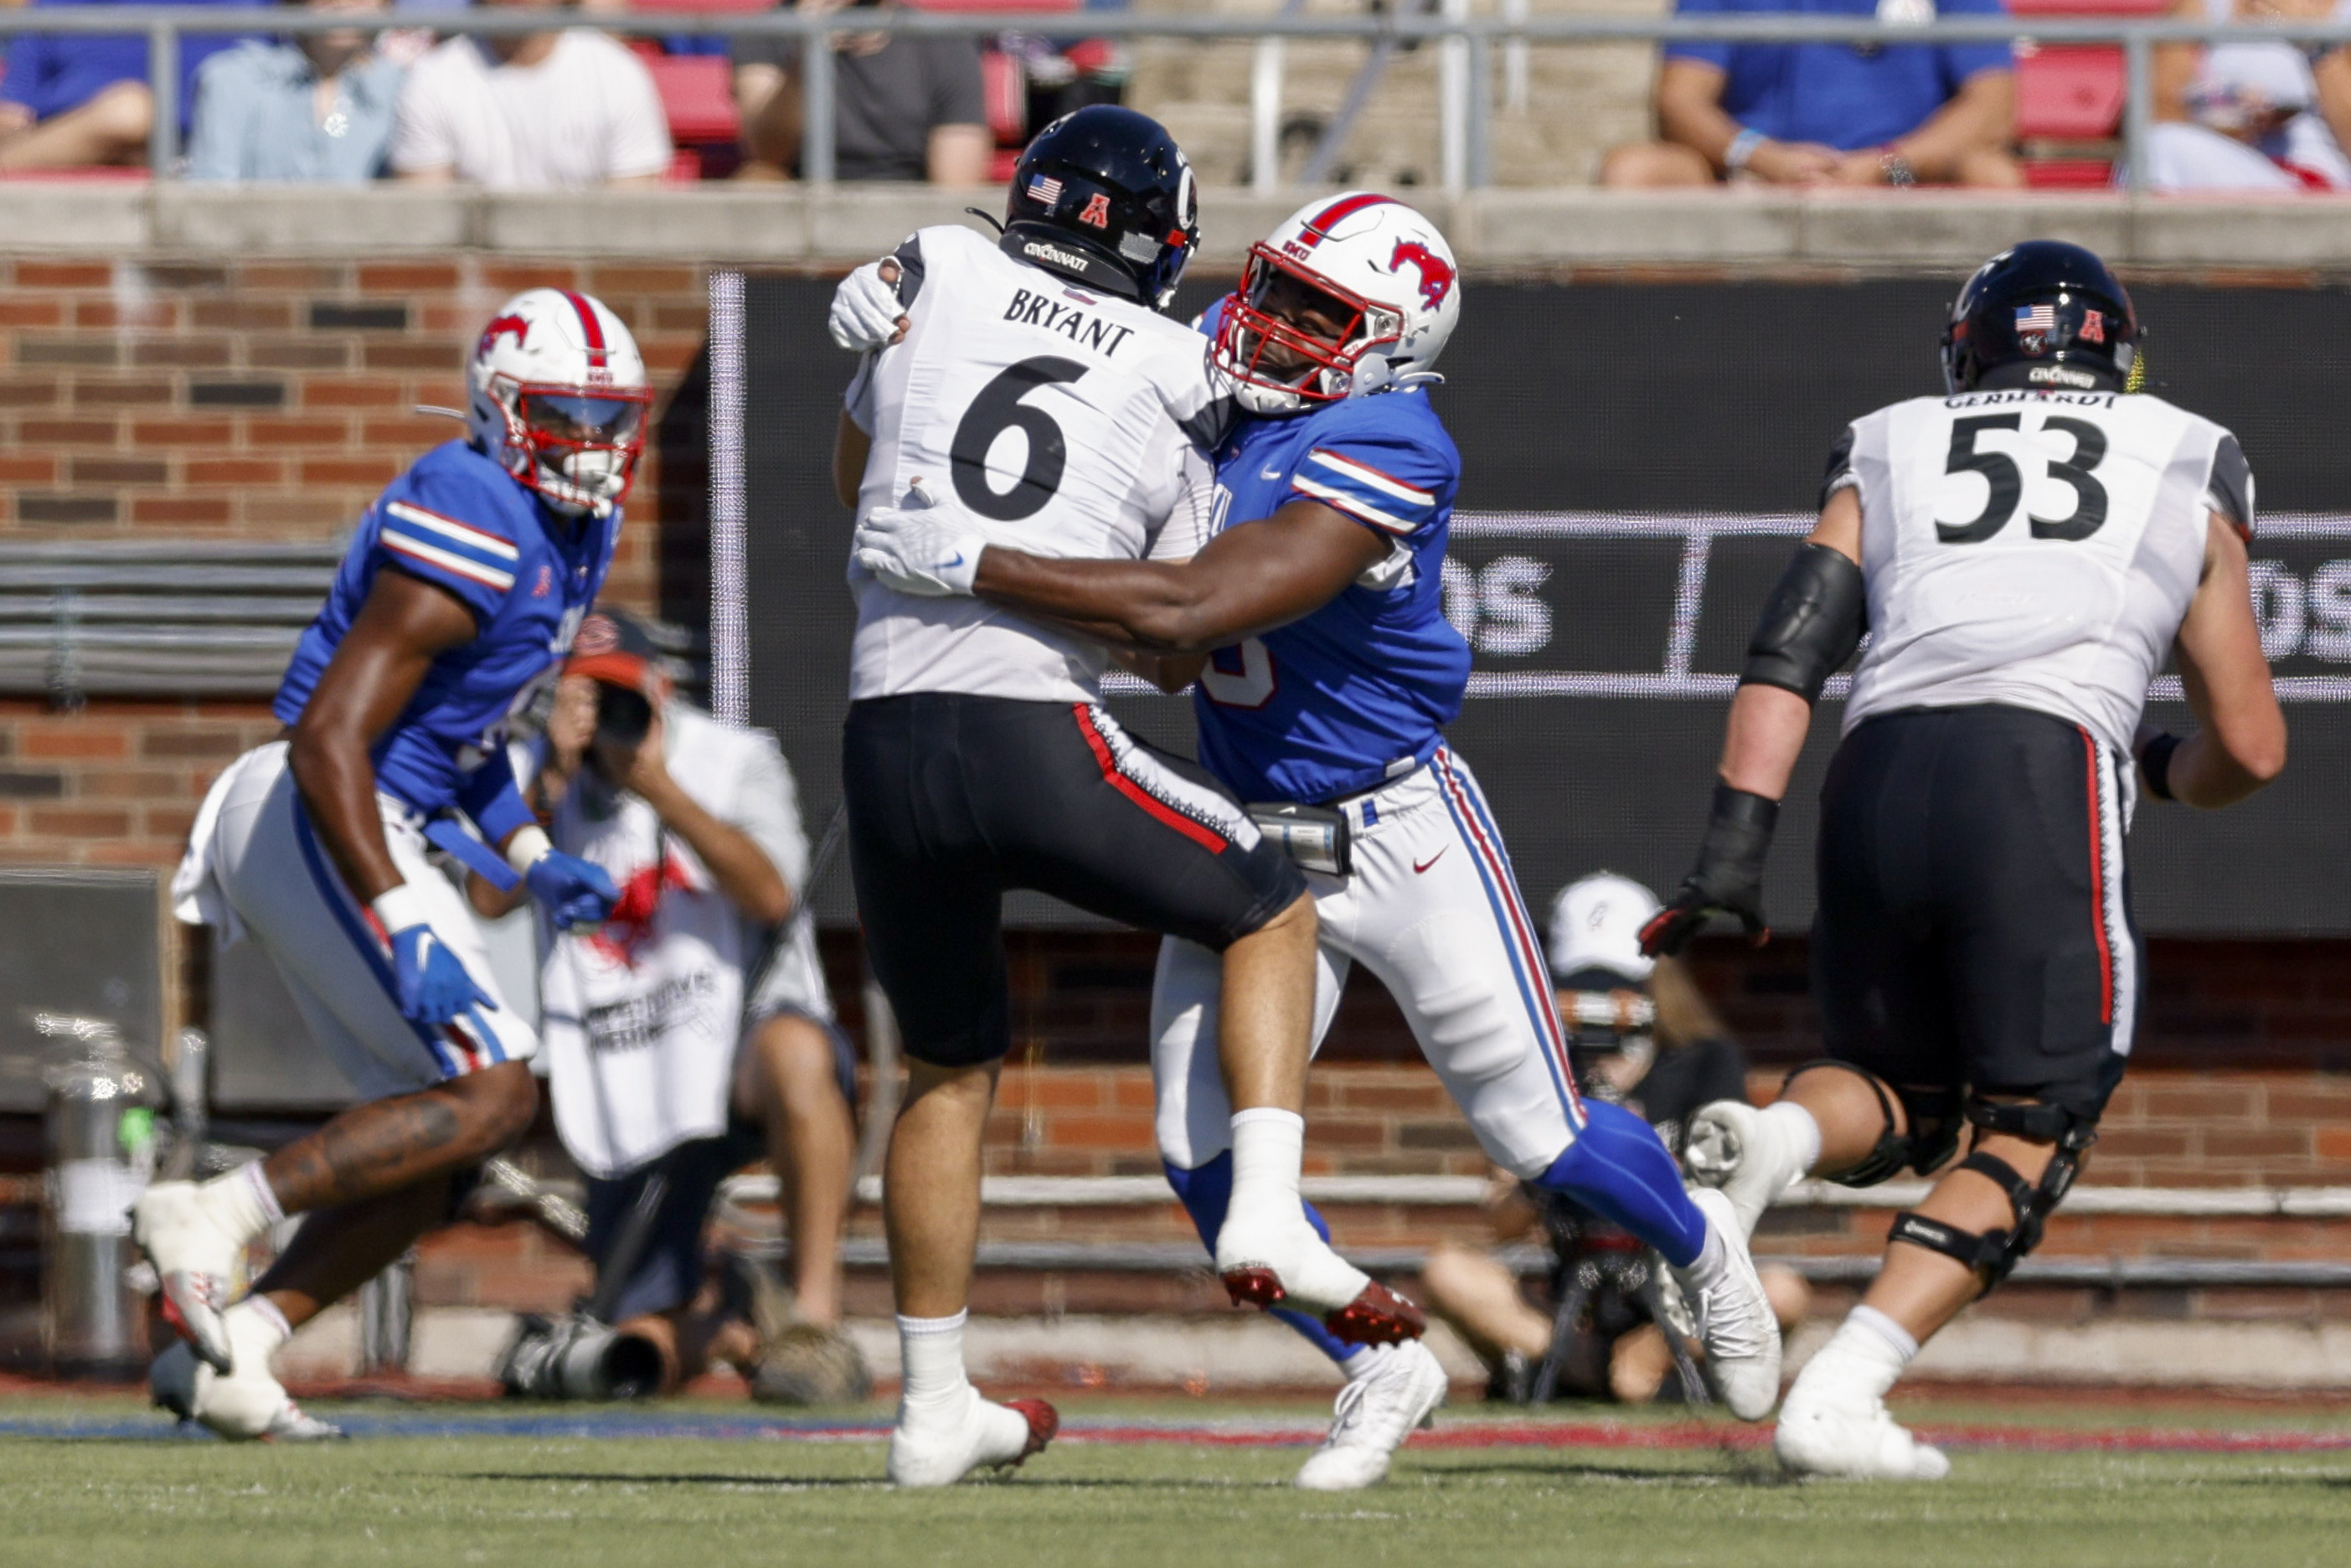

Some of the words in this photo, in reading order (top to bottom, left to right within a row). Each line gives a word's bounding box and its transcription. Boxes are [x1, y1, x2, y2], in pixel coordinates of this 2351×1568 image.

[1023, 242, 1089, 272] CINCINNATI
[1003, 287, 1135, 358] BRYANT
[950, 354, 1090, 522] 6
[1934, 412, 2109, 544] 53
